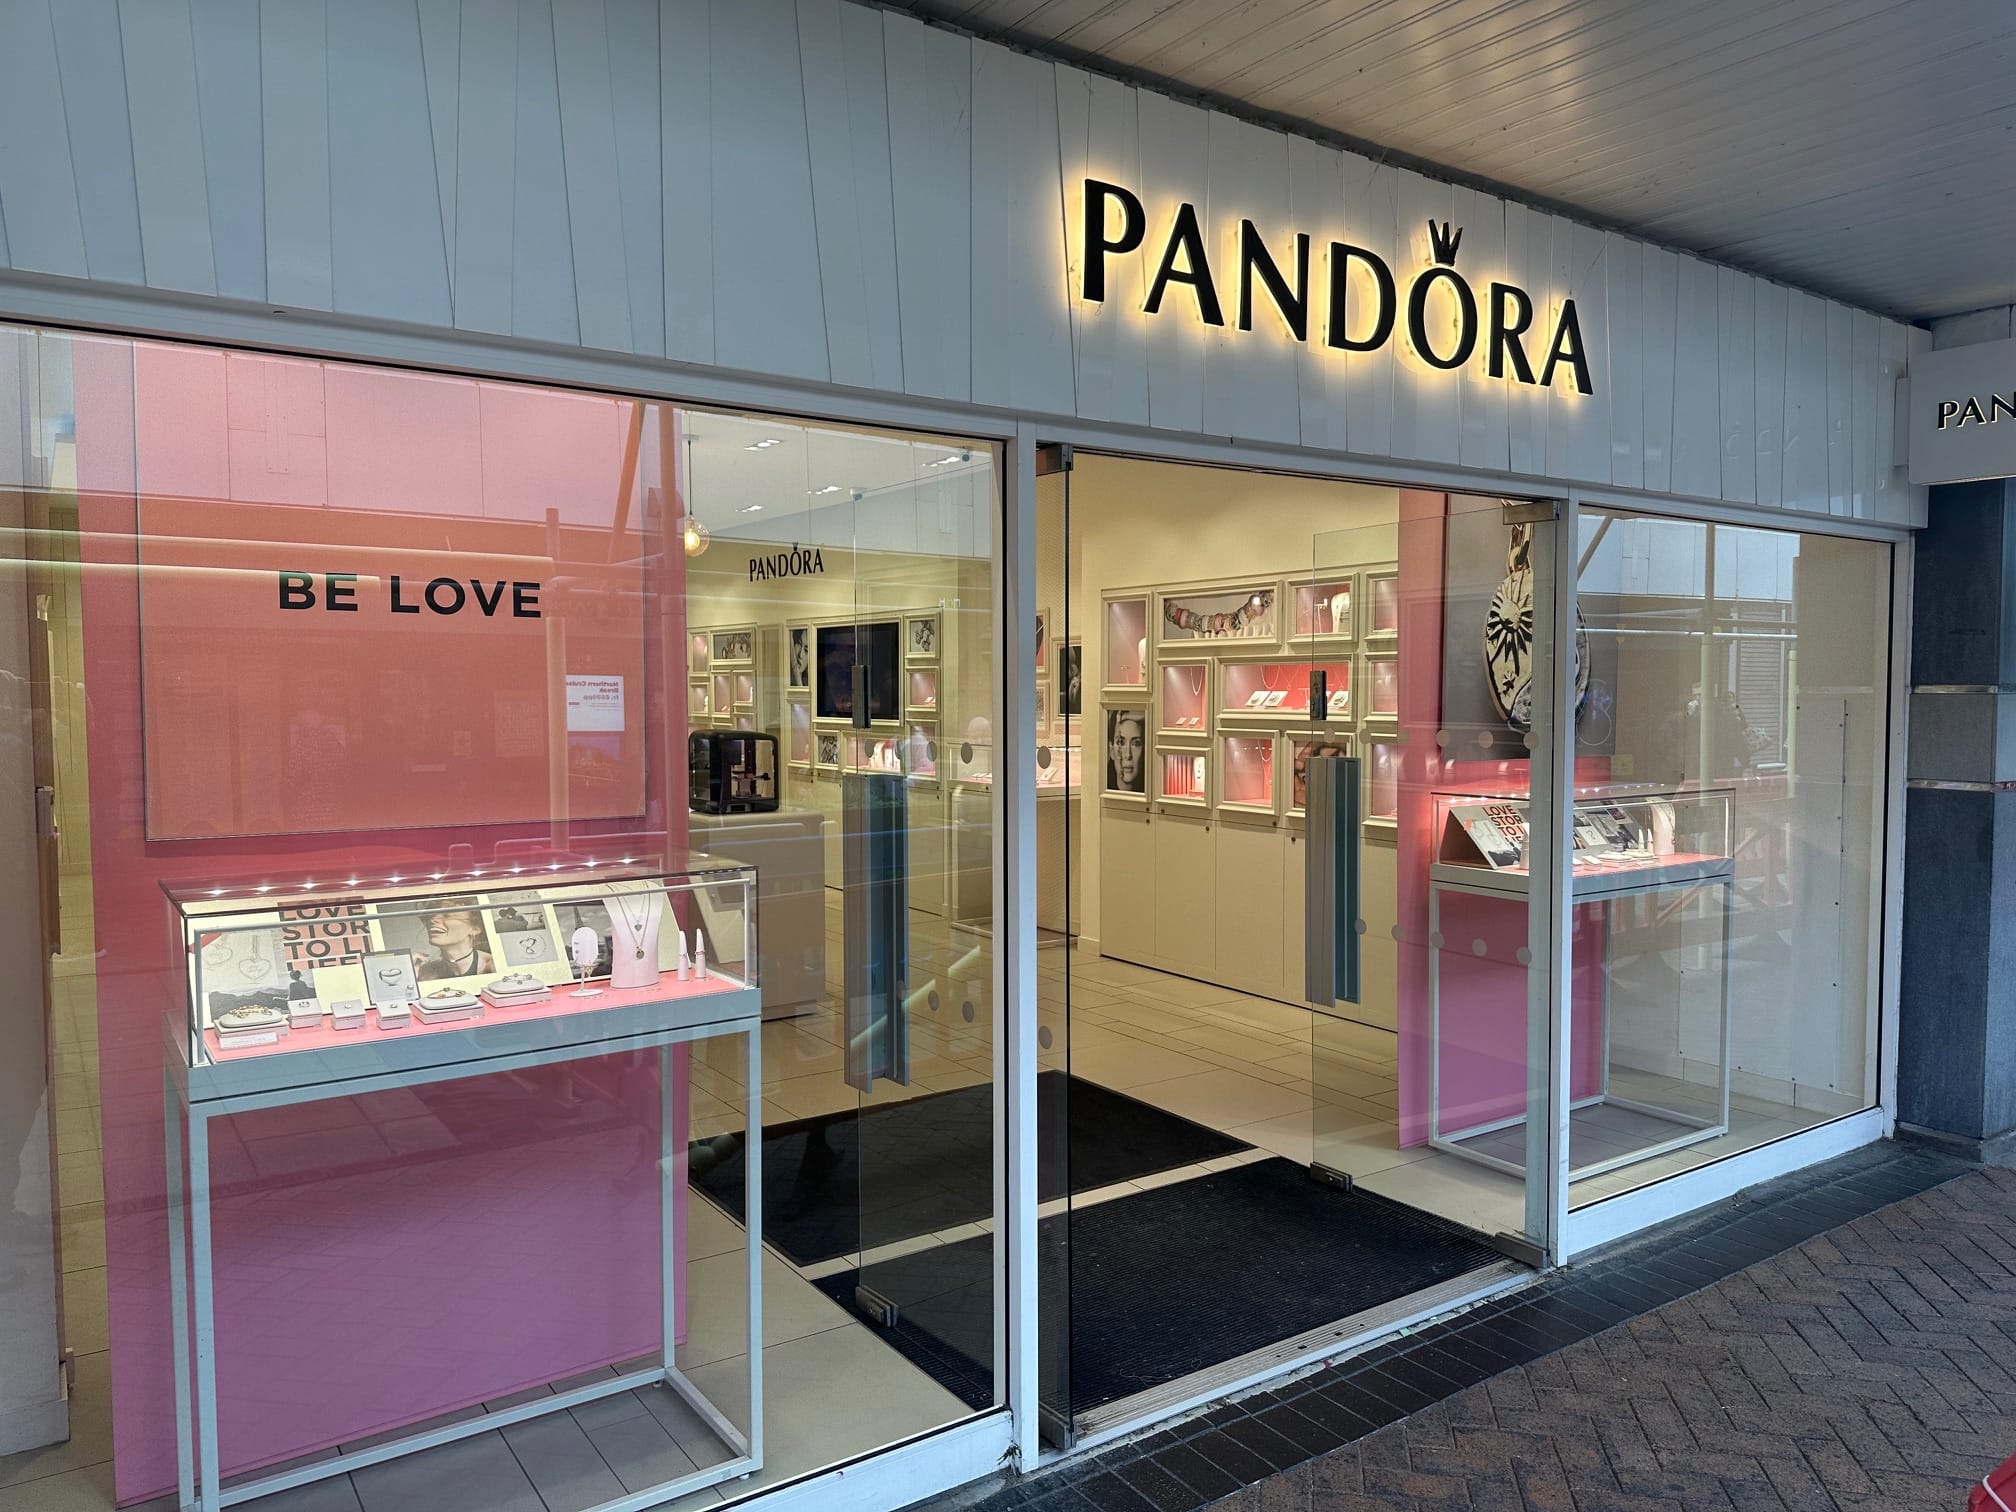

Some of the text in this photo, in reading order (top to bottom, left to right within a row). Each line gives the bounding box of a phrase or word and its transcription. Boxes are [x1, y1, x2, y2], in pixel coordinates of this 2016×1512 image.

[1083, 178, 1593, 396] PANDORA
[1937, 392, 2016, 430] PAN
[749, 546, 824, 582] PANDORA
[279, 570, 541, 618] BE LOVE
[1482, 805, 1516, 816] LOVE
[1490, 815, 1523, 827] STOR
[1497, 826, 1516, 836] TO
[278, 903, 367, 922] LOVE
[283, 939, 331, 959] TO
